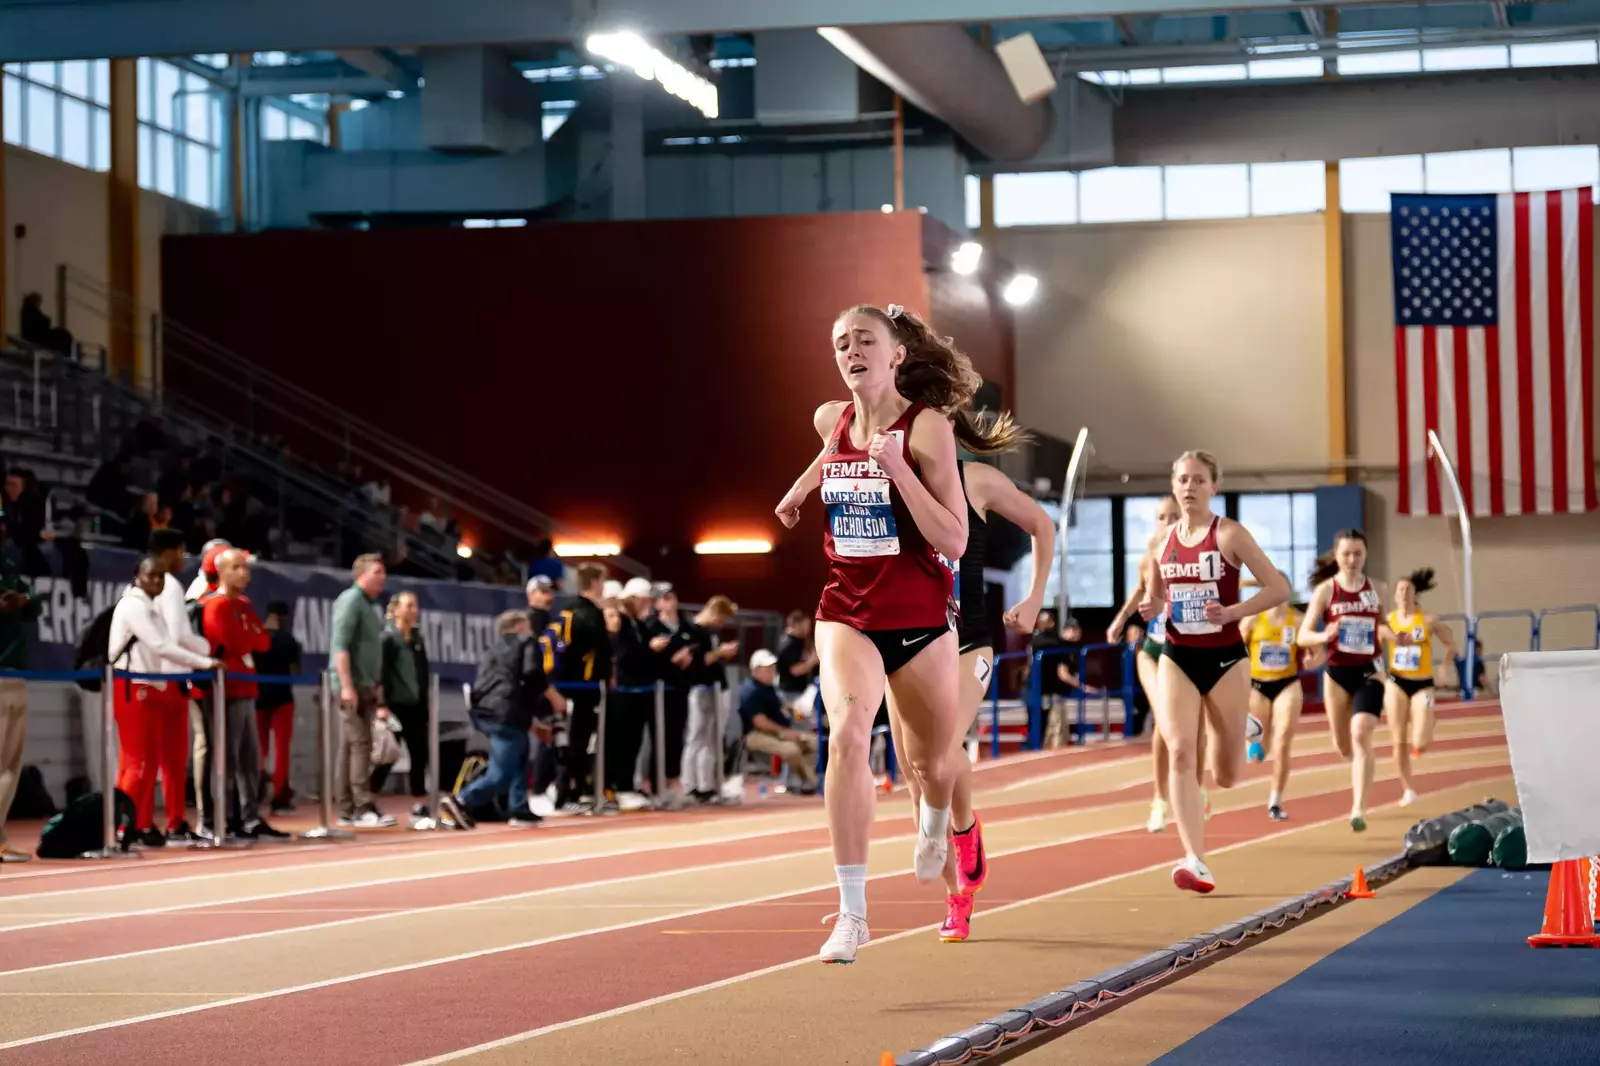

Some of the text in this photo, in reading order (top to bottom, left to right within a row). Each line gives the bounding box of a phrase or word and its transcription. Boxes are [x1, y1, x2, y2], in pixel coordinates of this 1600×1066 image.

[824, 491, 884, 504] AMERICAN
[842, 505, 871, 516] LAURA
[1160, 563, 1226, 579] TEMPE
[1205, 554, 1214, 578] 1
